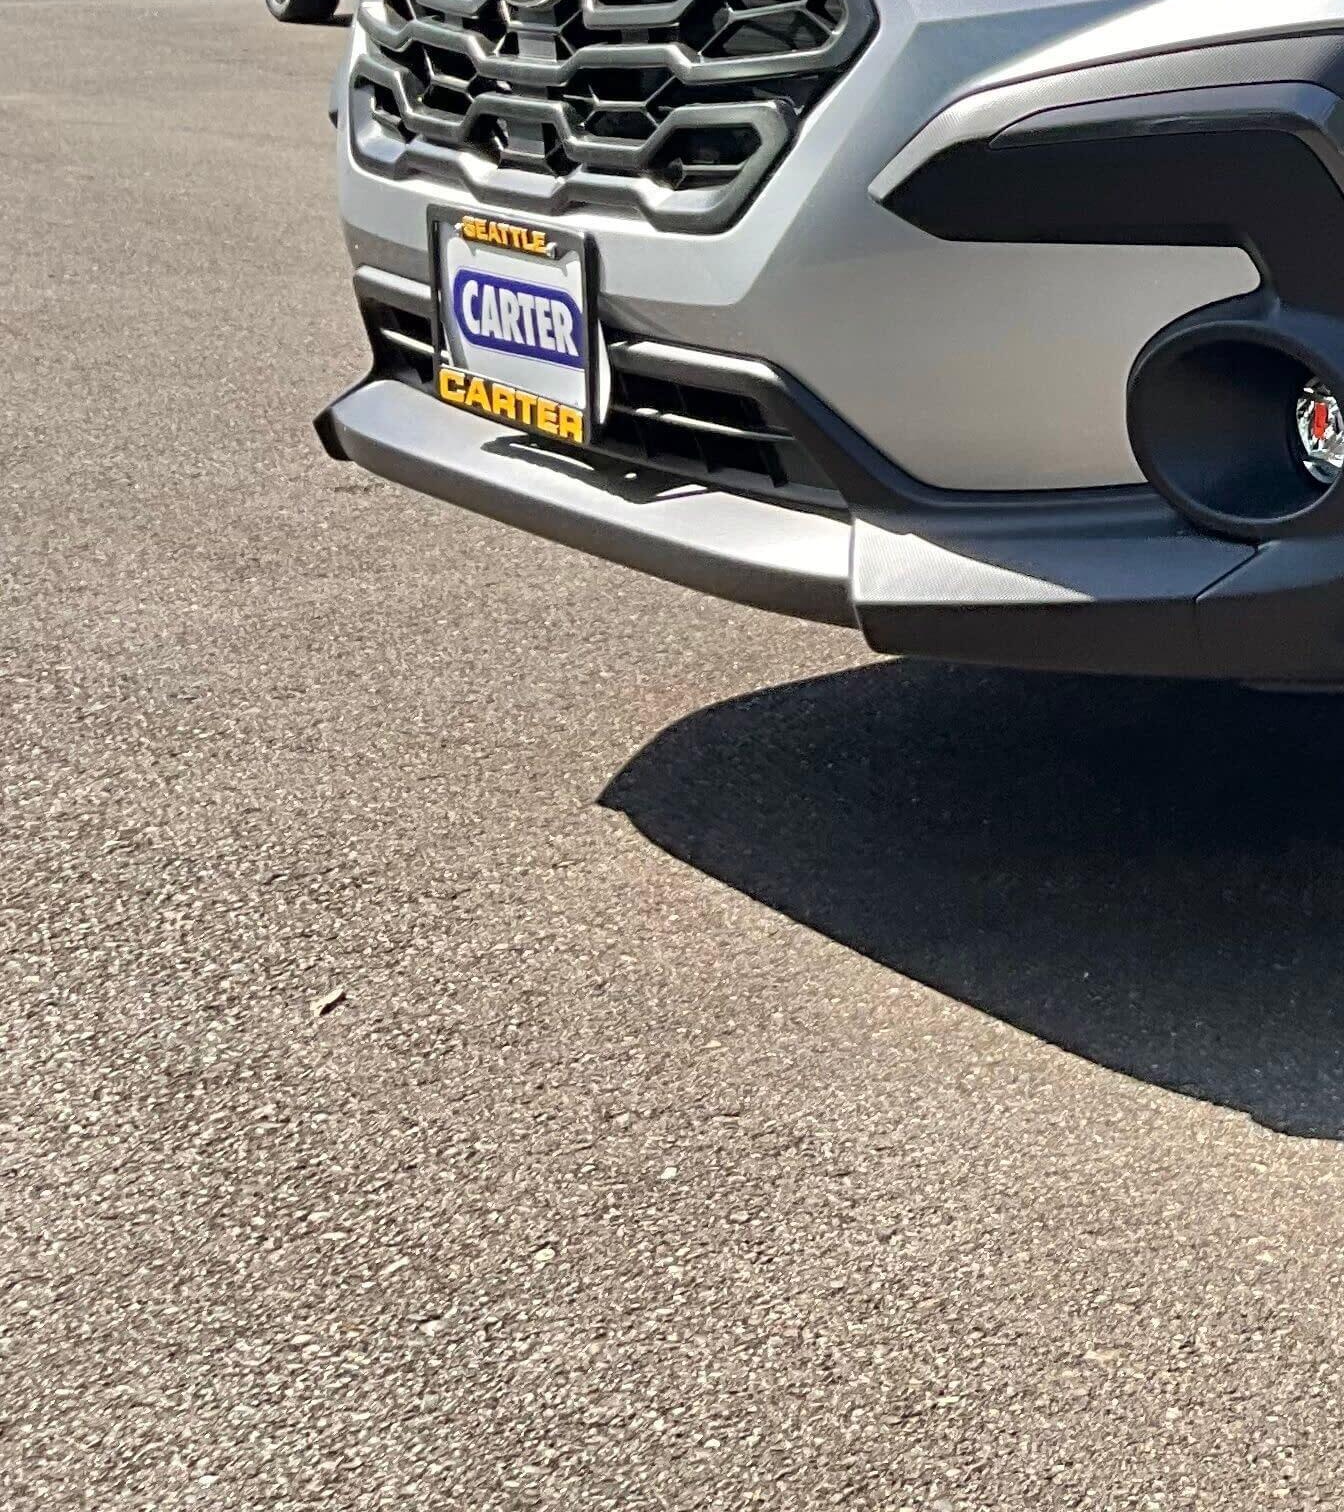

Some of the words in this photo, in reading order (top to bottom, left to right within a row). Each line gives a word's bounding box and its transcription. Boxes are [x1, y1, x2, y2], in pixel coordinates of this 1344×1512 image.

[461, 215, 548, 255] SEATTLE
[462, 279, 579, 357] CARTER
[439, 367, 584, 444] CARTER
